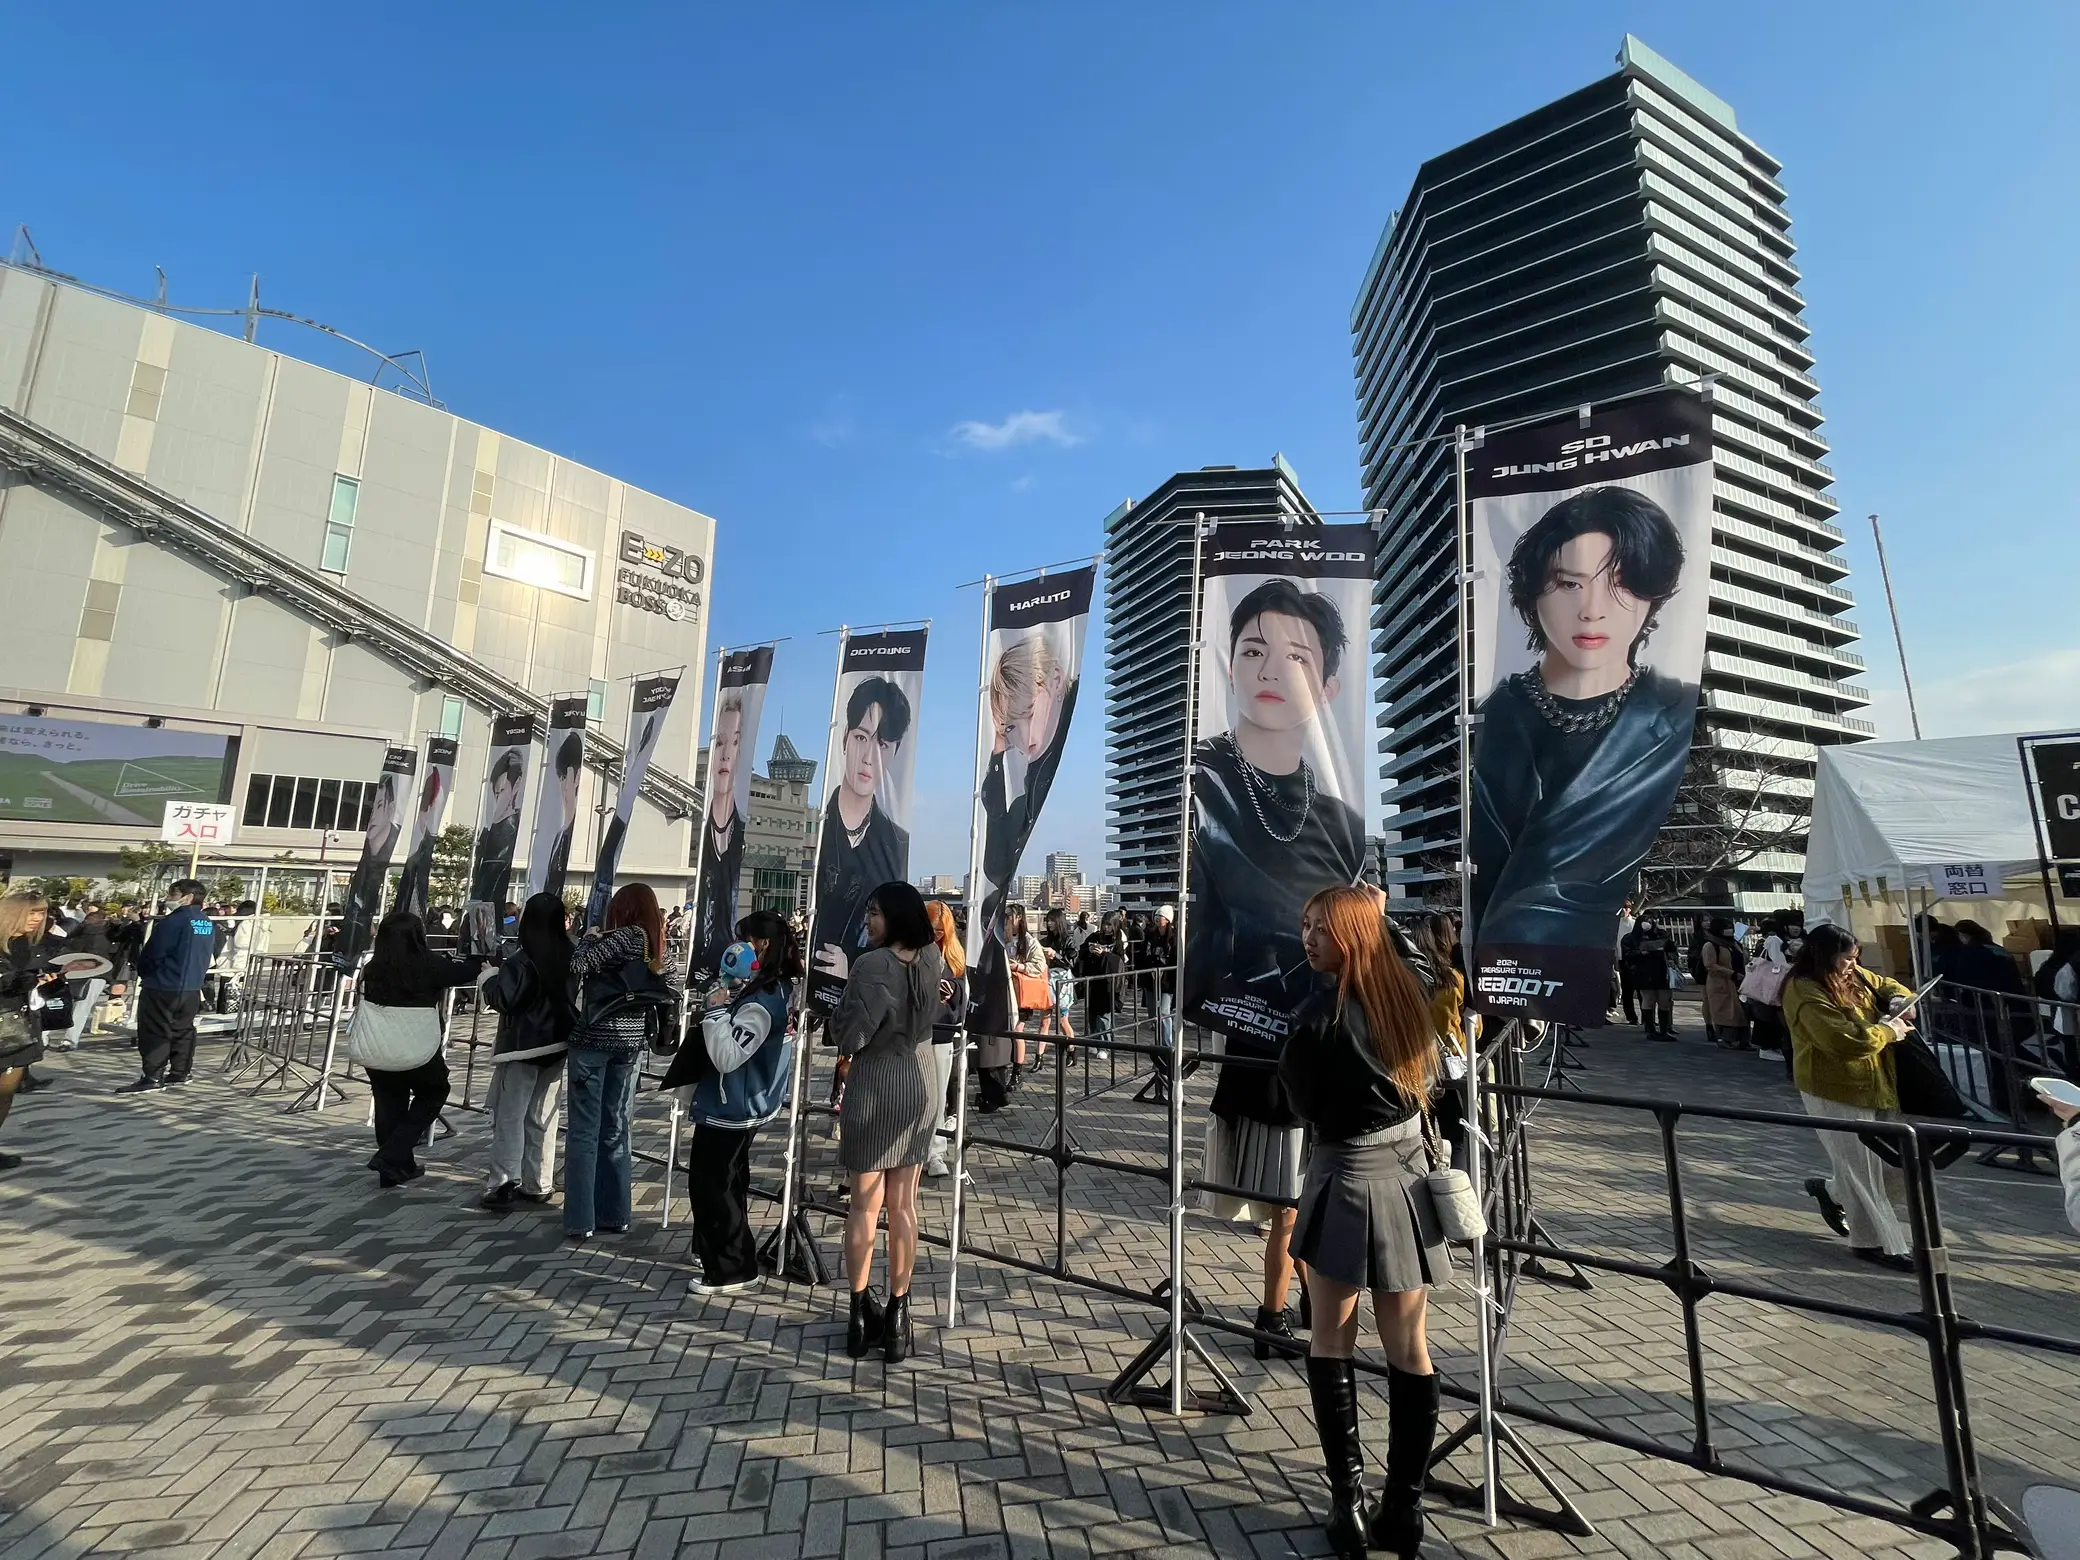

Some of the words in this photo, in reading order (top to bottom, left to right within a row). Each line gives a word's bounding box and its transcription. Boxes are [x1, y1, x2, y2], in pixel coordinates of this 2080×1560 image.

[1561, 435, 1611, 455] SO
[1491, 456, 1578, 479] JUNG
[1584, 434, 1690, 465] HWAN
[1250, 539, 1321, 549] PARK
[1213, 551, 1294, 562] JEONG
[1299, 551, 1366, 562] WOO
[617, 567, 701, 607] FUKUOKA
[616, 587, 667, 615] BOSS
[1009, 589, 1071, 612] HARUTO
[172, 806, 227, 822] ガチャ
[177, 823, 218, 839] 入口
[1944, 864, 1984, 878] 両替
[1948, 882, 1988, 896] 窓口
[1496, 959, 1518, 967] 2024
[1480, 967, 1516, 975] TREASURE
[1518, 967, 1542, 976] TOUR
[1220, 996, 1266, 1013] TREASURE
[1244, 993, 1268, 1006] 2024
[1496, 996, 1528, 1007] JAPAN
[1201, 999, 1289, 1035] REBOO
[732, 1026, 756, 1049] 07
[1227, 1019, 1238, 1029] IN
[1239, 1024, 1276, 1042] JAPAN
